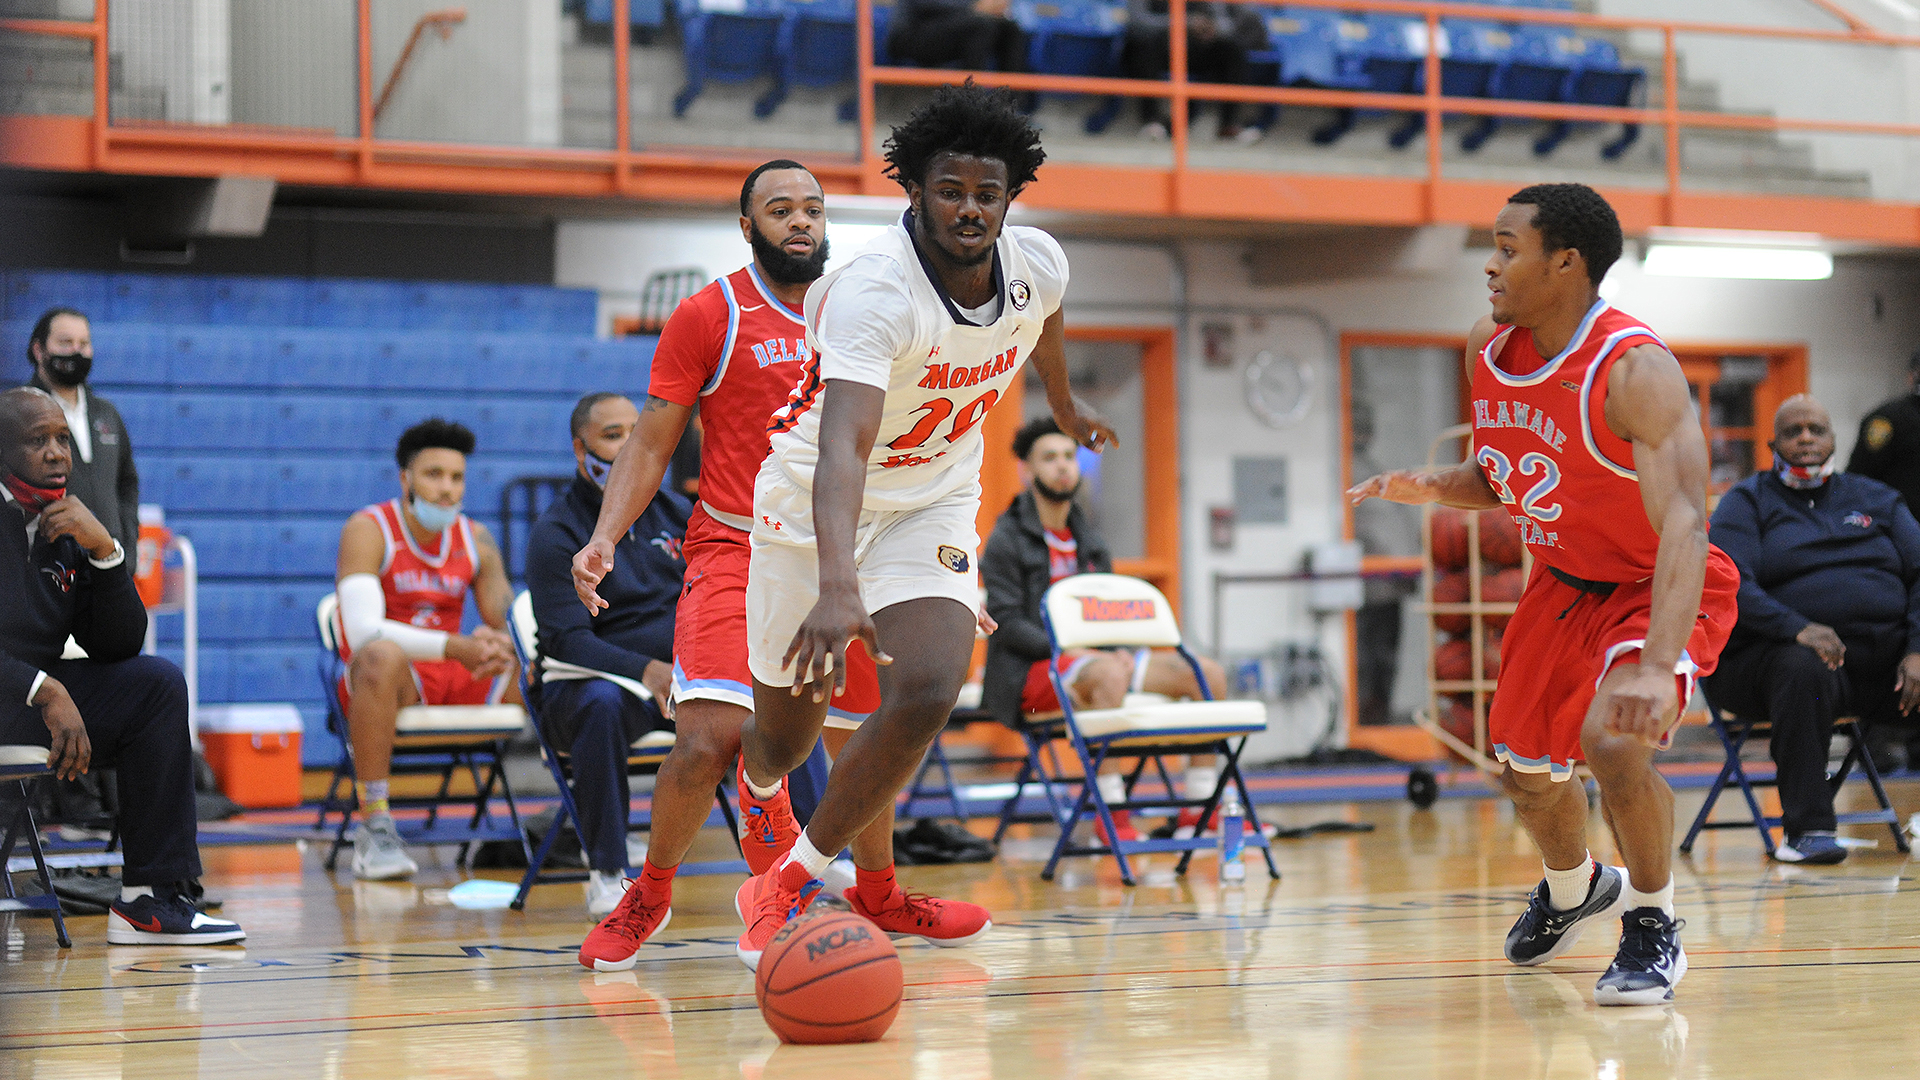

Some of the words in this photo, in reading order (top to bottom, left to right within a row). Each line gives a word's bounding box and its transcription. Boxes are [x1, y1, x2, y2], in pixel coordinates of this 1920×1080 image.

[917, 345, 1018, 390] MORGAN
[883, 388, 999, 450] 20
[1473, 399, 1567, 454] DELAWARE
[1477, 445, 1563, 522] 32
[1073, 596, 1155, 621] MORGAN
[806, 926, 874, 961] NCAA
